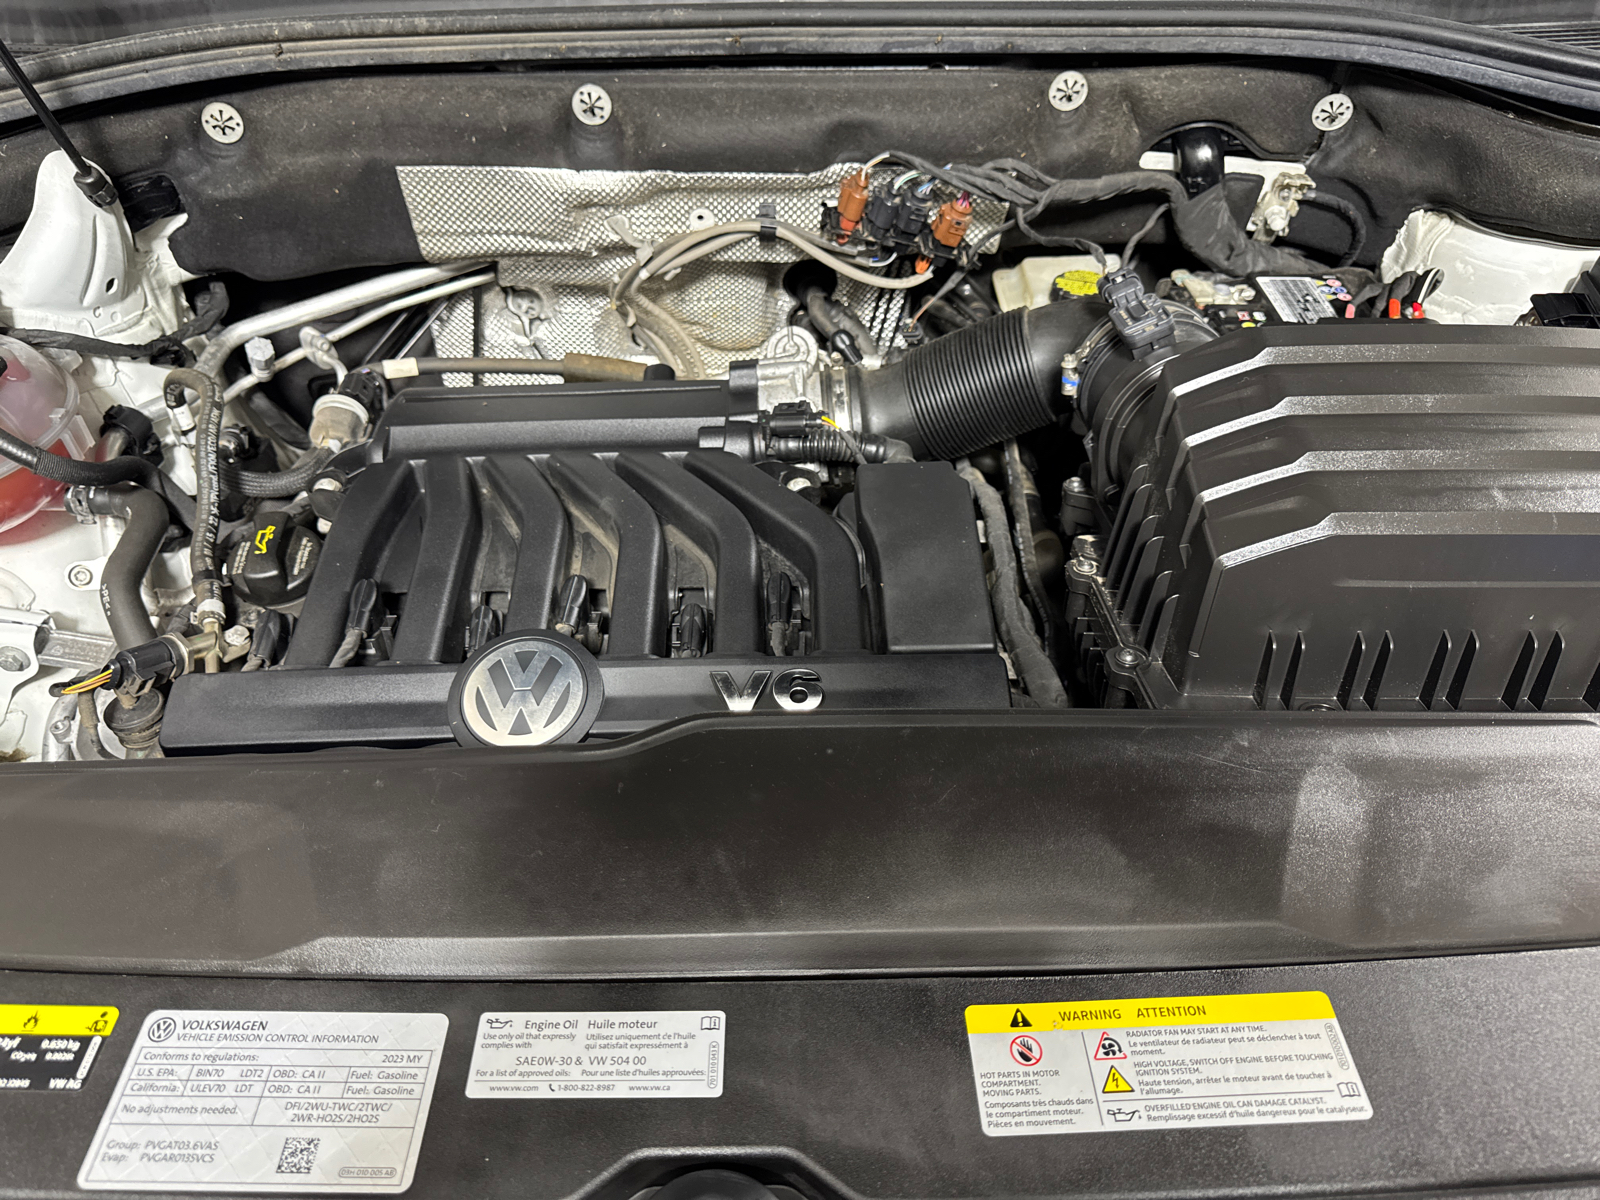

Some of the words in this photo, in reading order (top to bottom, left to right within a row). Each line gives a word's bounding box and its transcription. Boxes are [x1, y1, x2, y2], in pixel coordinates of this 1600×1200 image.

[461, 636, 588, 746] VW
[709, 668, 825, 712] V6
[1058, 1009, 1122, 1022] WARNING
[1136, 1005, 1207, 1019] ATTENTION
[182, 1020, 268, 1031] VOLKSWAGEN
[524, 1020, 561, 1032] Engine
[563, 1020, 579, 1029] Oil
[588, 1019, 616, 1029] Huile
[618, 1020, 658, 1029] moteur
[148, 1017, 176, 1042] VW
[1126, 1030, 1162, 1038] RADIATOR
[1180, 1028, 1196, 1036] MAY
[1197, 1027, 1219, 1035] START
[1247, 1025, 1267, 1033] TIME.
[177, 1033, 215, 1042] VEHICLE
[217, 1033, 263, 1042] EMISSION
[265, 1034, 309, 1043] CONTROL
[311, 1035, 379, 1043] INFORMATION
[499, 1033, 515, 1041] only
[542, 1033, 576, 1041] expressly
[615, 1033, 660, 1042] uniquement
[662, 1032, 672, 1040] de
[673, 1032, 696, 1040] l'huile
[1128, 1040, 1137, 1048] Le
[1139, 1038, 1179, 1047] ventilateur
[1192, 1037, 1226, 1045] radiateur
[1228, 1036, 1245, 1044] peut
[1256, 1034, 1297, 1042] déclencher
[481, 1042, 514, 1050] complies
[585, 1042, 597, 1051] qui
[630, 1041, 682, 1051] expressément
[684, 1041, 688, 1049] à
[144, 1051, 189, 1061] Conforms
[191, 1053, 201, 1061] to
[203, 1053, 259, 1063] regulations:
[382, 1055, 404, 1063] 2023
[406, 1055, 423, 1063] MY
[574, 1056, 583, 1066] &
[589, 1056, 608, 1065] VW
[610, 1056, 630, 1065] 504
[632, 1056, 647, 1065] 00
[1190, 1058, 1219, 1066] SWITCH
[1219, 1057, 1234, 1065] OFF
[1236, 1056, 1264, 1064] ENGINE
[1264, 1055, 1293, 1063] BEFORE
[1294, 1053, 1334, 1061] TOUCHING
[137, 1068, 155, 1077] U.S.
[157, 1068, 178, 1077] EPA:
[196, 1069, 224, 1078] BIN70
[240, 1069, 264, 1078] LDT2
[273, 1069, 298, 1079] OBD:
[302, 1069, 318, 1078] CA
[350, 1071, 373, 1080] Fuel:
[377, 1071, 418, 1080] Gasoline
[476, 1069, 488, 1077] For
[496, 1069, 510, 1077] list
[510, 1069, 518, 1077] of
[518, 1069, 554, 1078] approved
[555, 1069, 571, 1077] oils:
[581, 1069, 599, 1077] Pour
[661, 1068, 706, 1078] approuvées:
[997, 1071, 1021, 1079] PARTS
[1022, 1070, 1031, 1078] IN
[1032, 1070, 1060, 1078] MOTOR
[1136, 1068, 1170, 1077] IGNITION
[1171, 1067, 1203, 1075] SYSTEM.
[981, 1079, 1041, 1088] COMPARTMENT.
[1138, 1079, 1161, 1087] Haute
[1163, 1078, 1195, 1086] tension,
[1196, 1076, 1222, 1085] arrêter
[1232, 1075, 1260, 1083] moteur
[1296, 1072, 1325, 1080] toucher
[131, 1083, 180, 1092] California:
[190, 1084, 226, 1093] ULEV70
[234, 1085, 254, 1093] LDT
[268, 1084, 293, 1093] OBD:
[297, 1085, 313, 1094] CA
[346, 1086, 370, 1095] Fuel:
[373, 1086, 415, 1095] Gasoline
[557, 1084, 616, 1092] 1-800-822-8987
[983, 1088, 1015, 1097] MOVING
[1015, 1088, 1042, 1096] PARTS.
[1140, 1087, 1183, 1096] l'allumage.
[984, 1100, 1031, 1110] Composants
[1032, 1098, 1047, 1107] très
[1048, 1098, 1074, 1106] chauds
[1076, 1097, 1094, 1105] dans
[1144, 1104, 1191, 1112] OVERFILLED
[1193, 1102, 1222, 1110] ENGINE
[1222, 1101, 1236, 1109] OIL
[1237, 1100, 1253, 1108] CAN
[1254, 1099, 1287, 1107] DAMAGE
[1288, 1097, 1327, 1105] CATALYST.
[121, 1105, 135, 1113] No
[138, 1105, 198, 1116] adjustments
[200, 1106, 238, 1115] needed.
[986, 1110, 993, 1118] le
[995, 1108, 1051, 1119] compartiment
[1053, 1108, 1084, 1116] moteur.
[1147, 1113, 1195, 1122] Remplissage
[1197, 1111, 1227, 1120] excessif
[1229, 1110, 1255, 1118] d'huile
[1256, 1109, 1296, 1118] dangereux
[1298, 1108, 1316, 1116] pour
[1317, 1106, 1324, 1114] le
[1326, 1105, 1368, 1115] catalyseur.
[987, 1120, 1013, 1128] Pièces
[1026, 1118, 1076, 1127] mouvement.
[106, 1140, 142, 1152] Group:
[102, 1152, 129, 1164] Evap:
